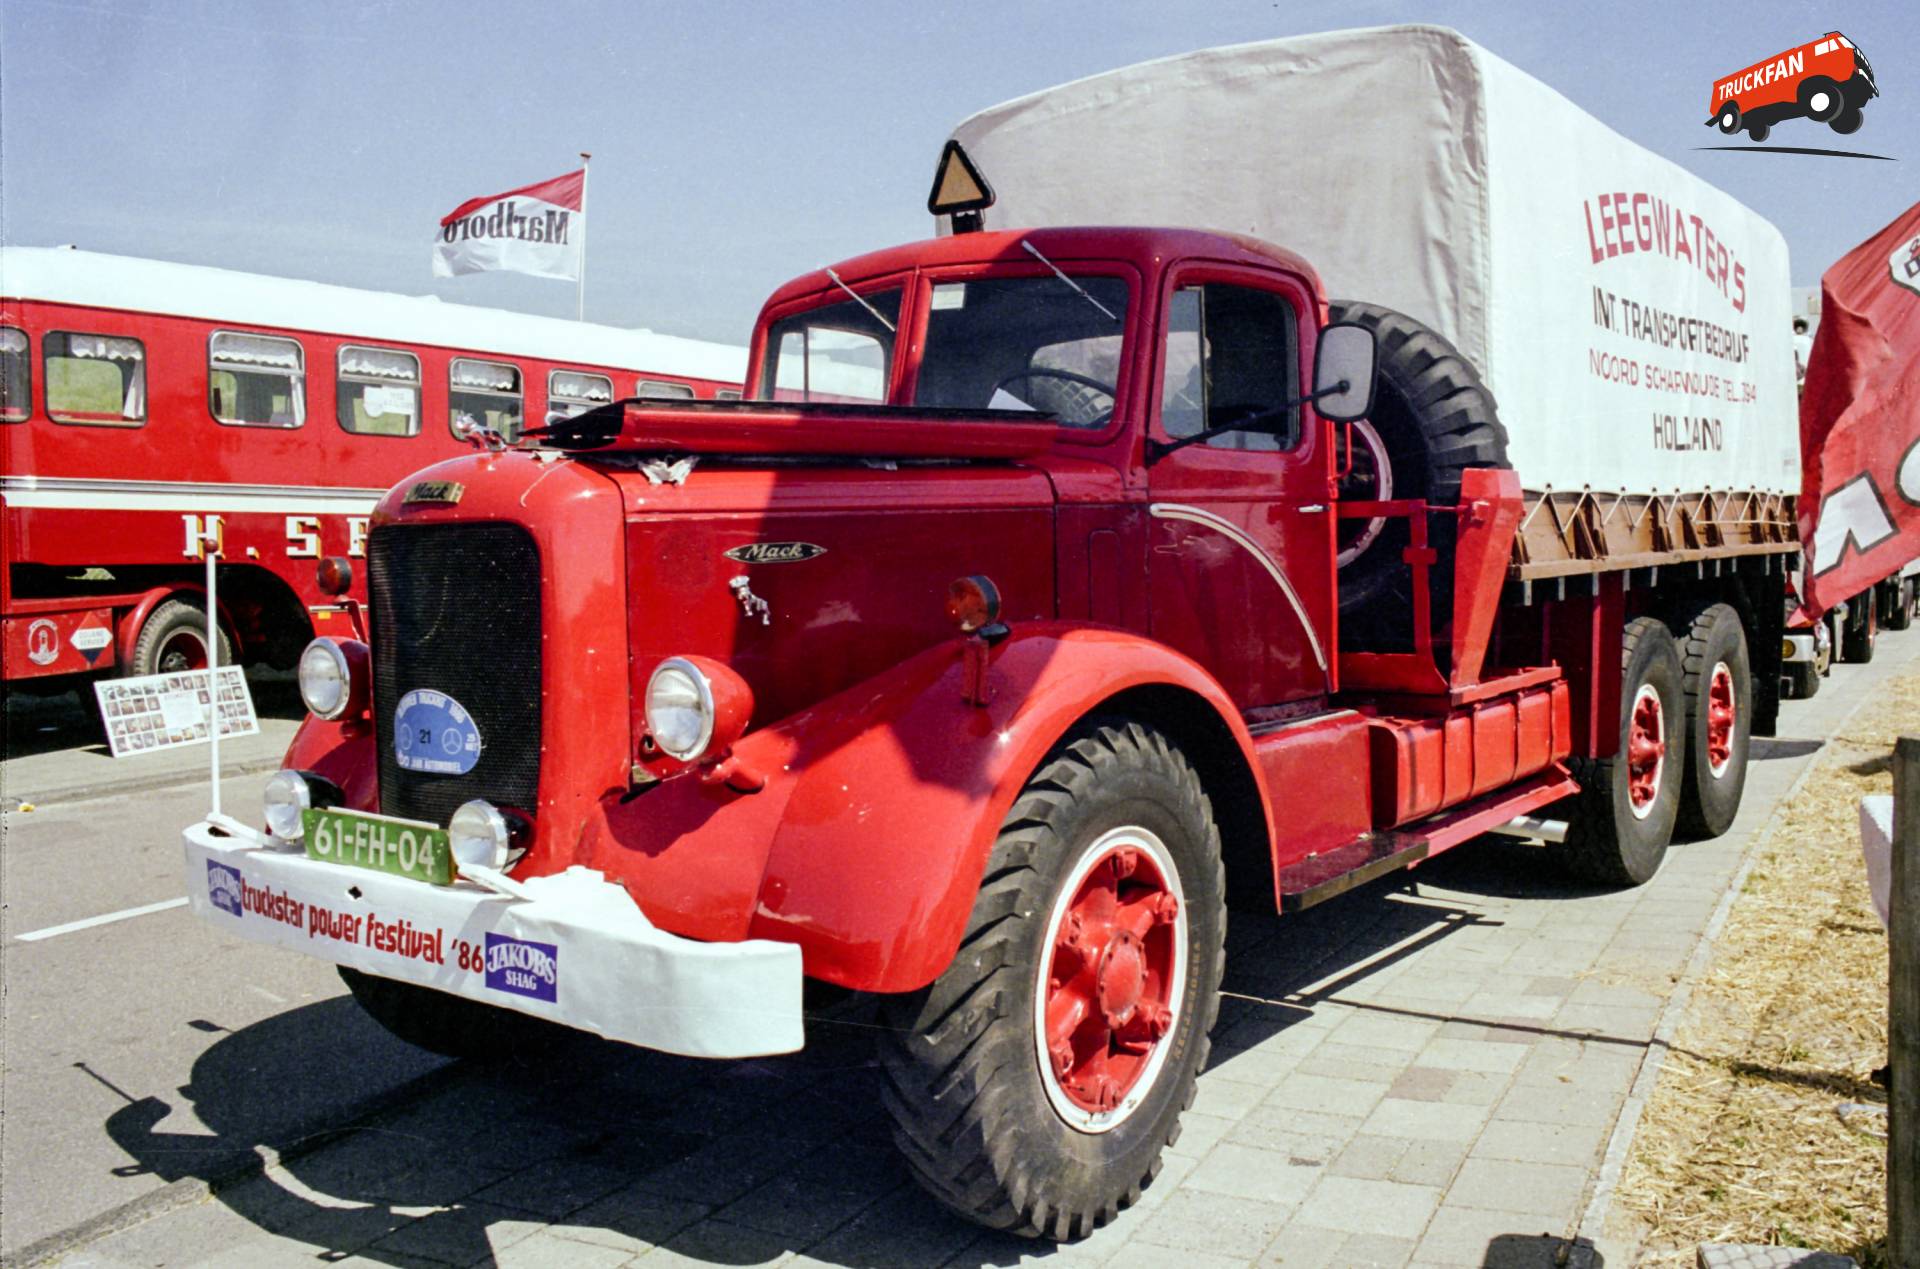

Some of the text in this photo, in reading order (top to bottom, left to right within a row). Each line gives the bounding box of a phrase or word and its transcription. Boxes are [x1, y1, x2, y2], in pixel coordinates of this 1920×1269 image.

[1584, 192, 1746, 314] LEEGWATER'S
[1593, 285, 1620, 334] INT.
[1589, 348, 1639, 386] NOORD
[1653, 412, 1722, 451] HOLLAND
[744, 543, 804, 561] Mack
[419, 729, 431, 744] 21
[314, 816, 436, 876] 61-FH-04
[241, 877, 484, 974] truckstar power festival '86
[487, 943, 556, 985] JAKOBS
[505, 969, 537, 990] SHAG
